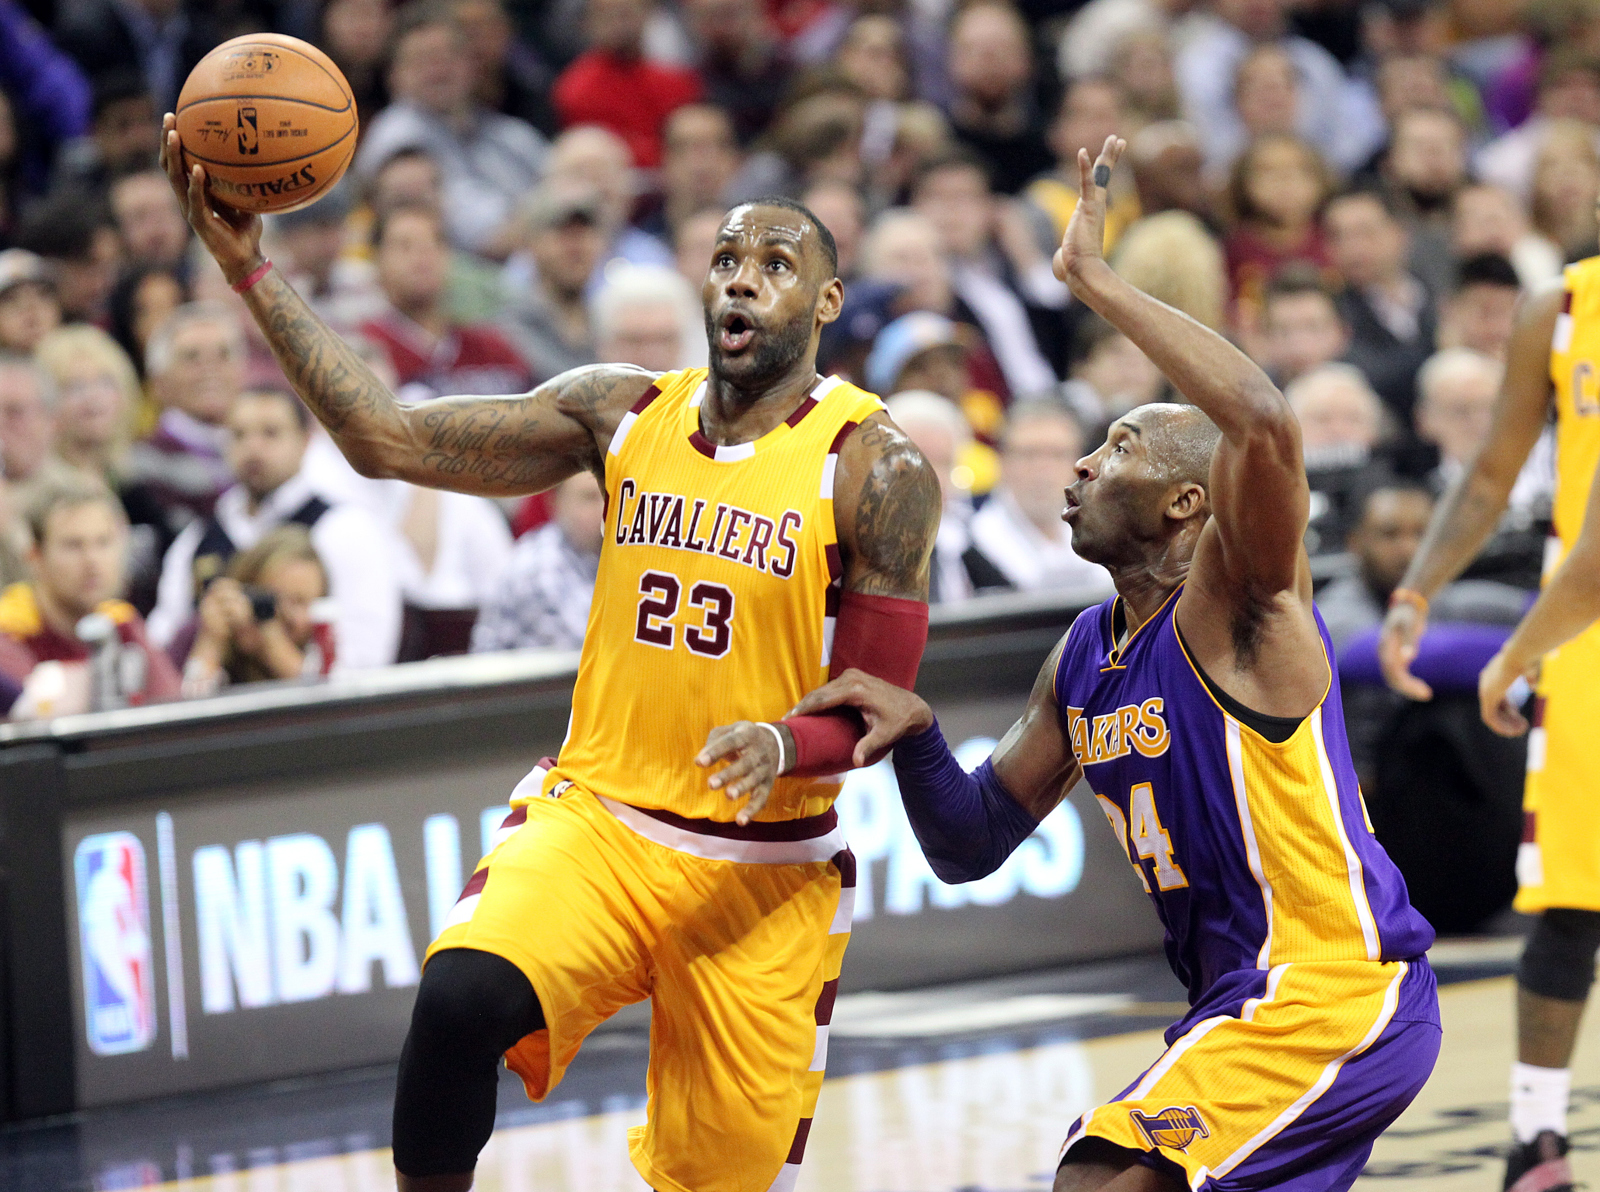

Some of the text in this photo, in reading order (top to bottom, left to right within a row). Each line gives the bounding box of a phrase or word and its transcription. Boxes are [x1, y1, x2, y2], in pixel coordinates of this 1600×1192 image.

[615, 477, 803, 580] CAVALIERS
[634, 568, 735, 660] 23
[193, 823, 421, 1015] NBA
